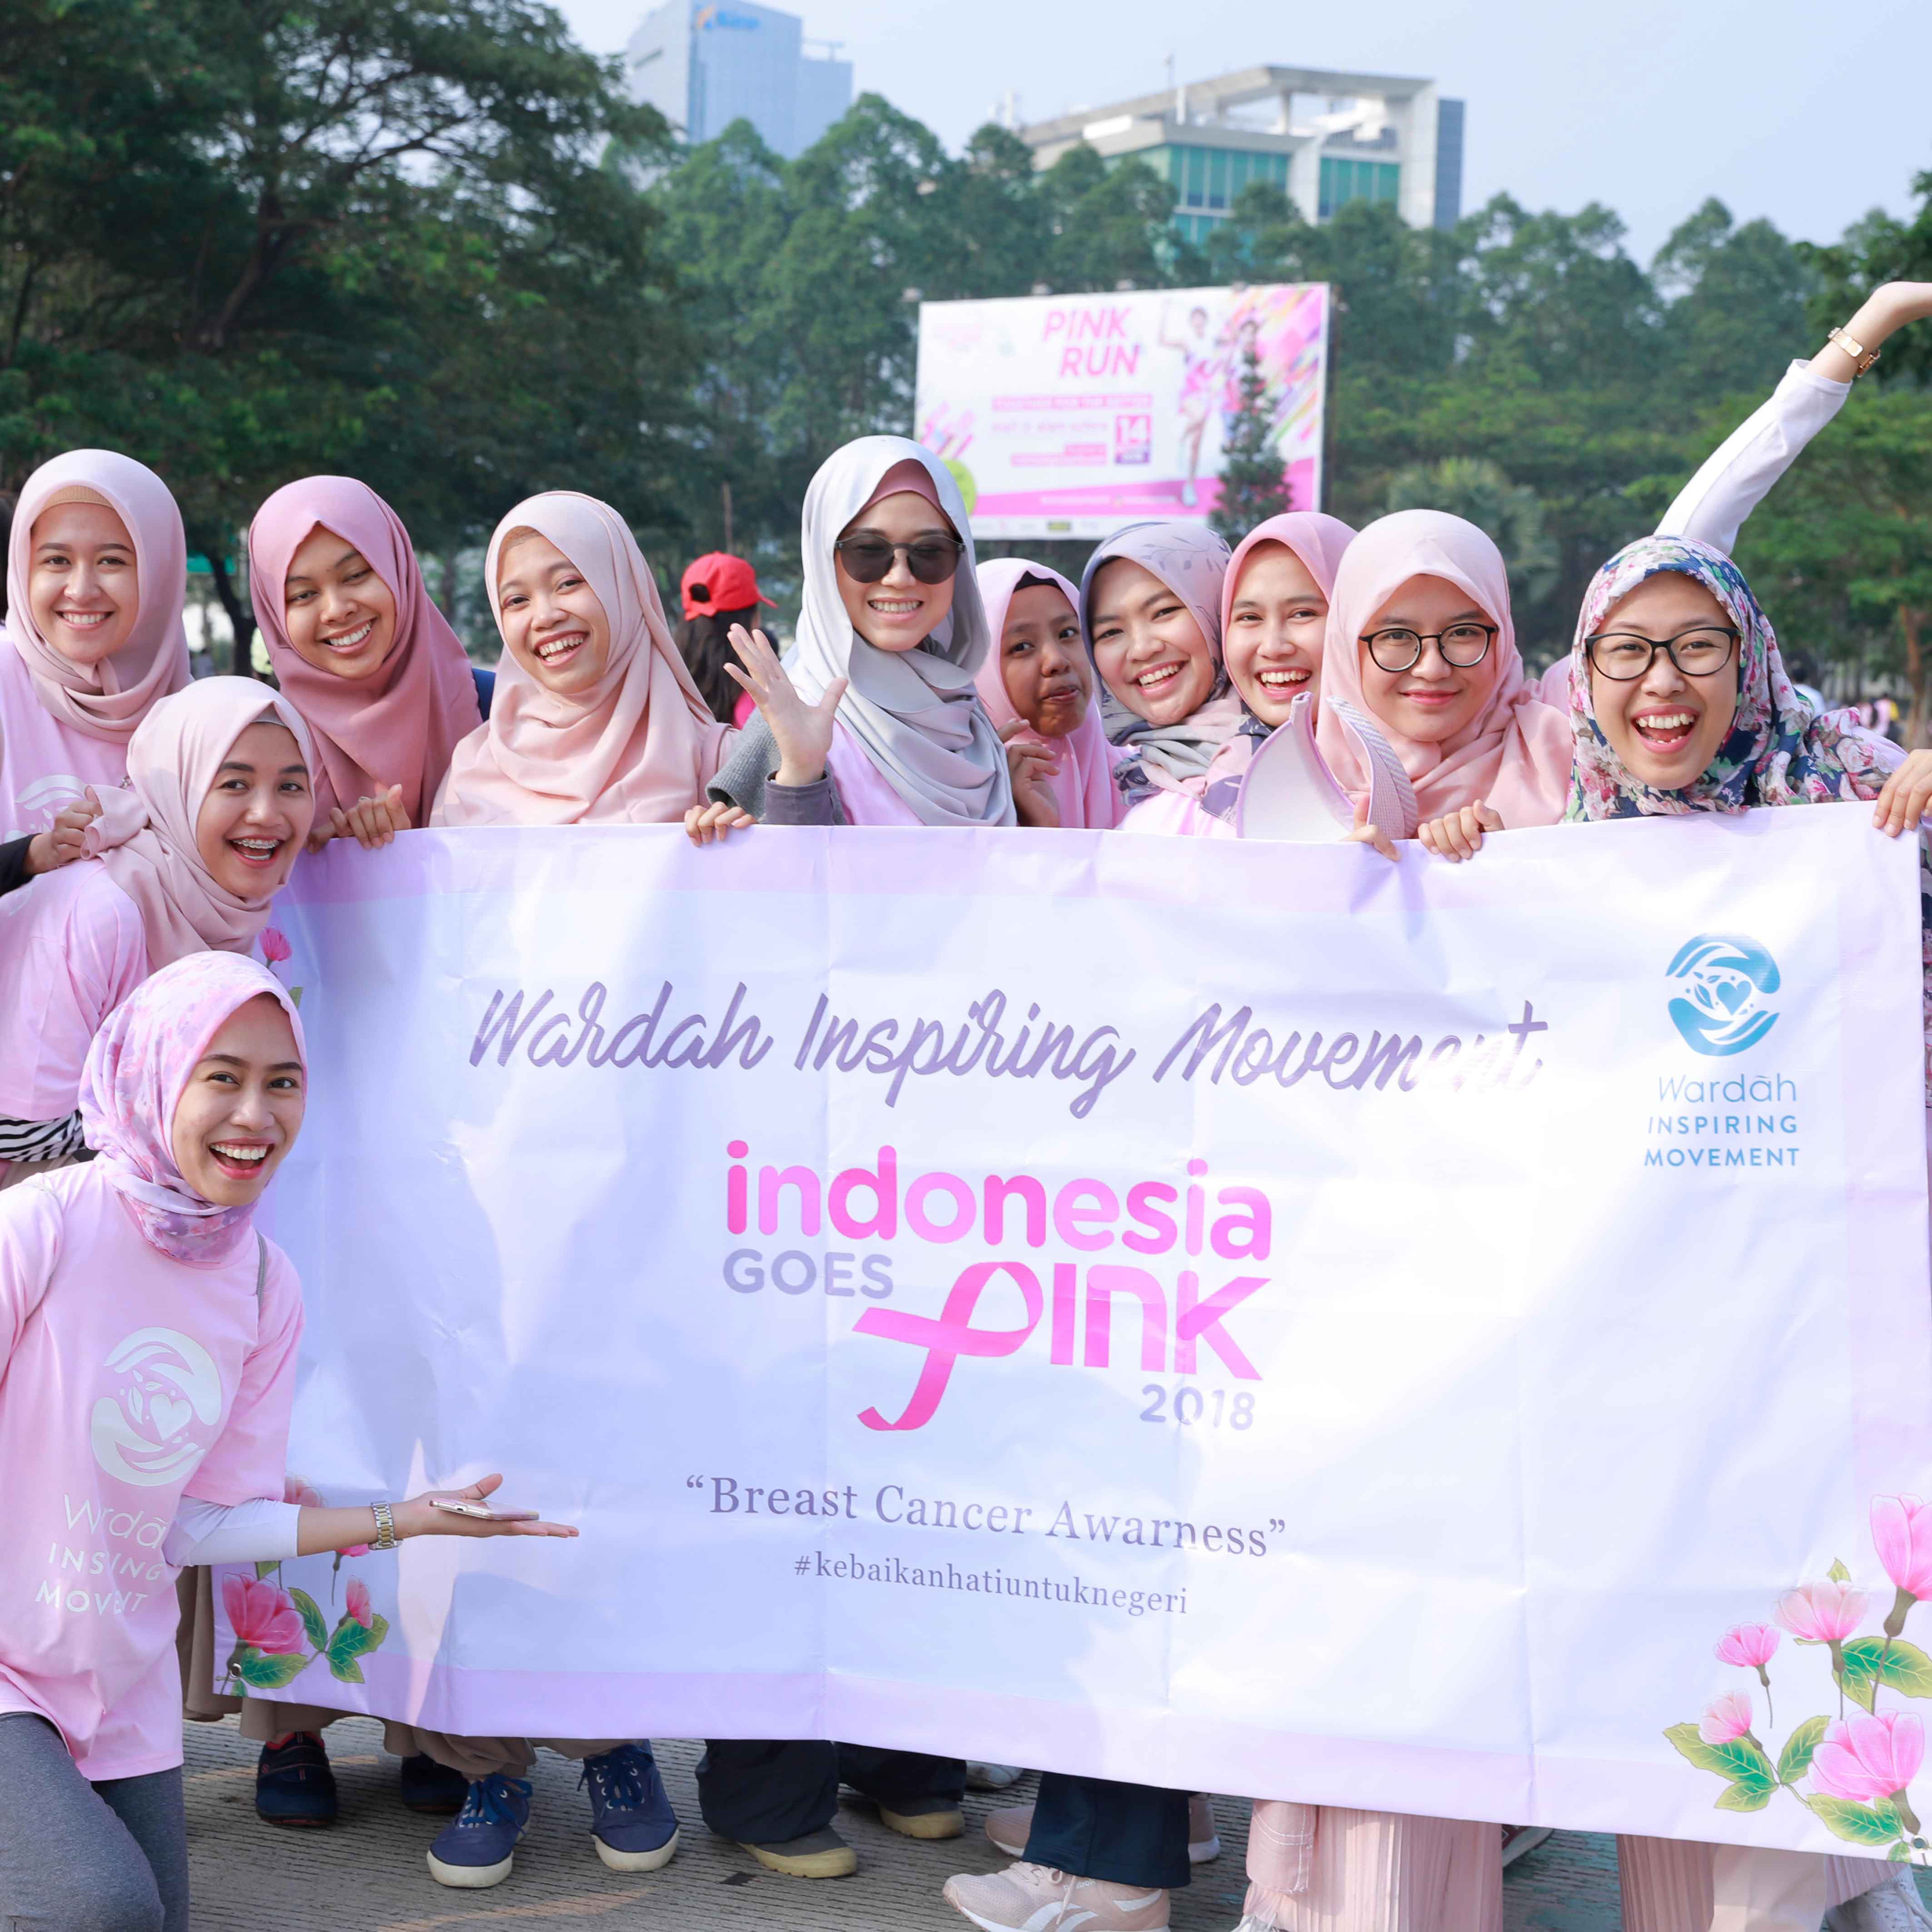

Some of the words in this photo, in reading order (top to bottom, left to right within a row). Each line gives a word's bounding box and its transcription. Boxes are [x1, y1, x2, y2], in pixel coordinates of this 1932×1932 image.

[1043, 307, 1132, 341] PINK
[1060, 343, 1141, 377] RUN
[470, 981, 773, 1070] Wardah
[794, 989, 1136, 1119] Inspiring
[1648, 1115, 1797, 1134] INSPIRING
[1644, 1148, 1799, 1167] MOVEMENT
[726, 1139, 1272, 1261] indonesia
[723, 1248, 894, 1299] GOES
[1140, 1384, 1256, 1430] 2018
[876, 1485, 1032, 1534] Cancer
[794, 1551, 1187, 1616] #kebaikanhatiuntuknegeri
